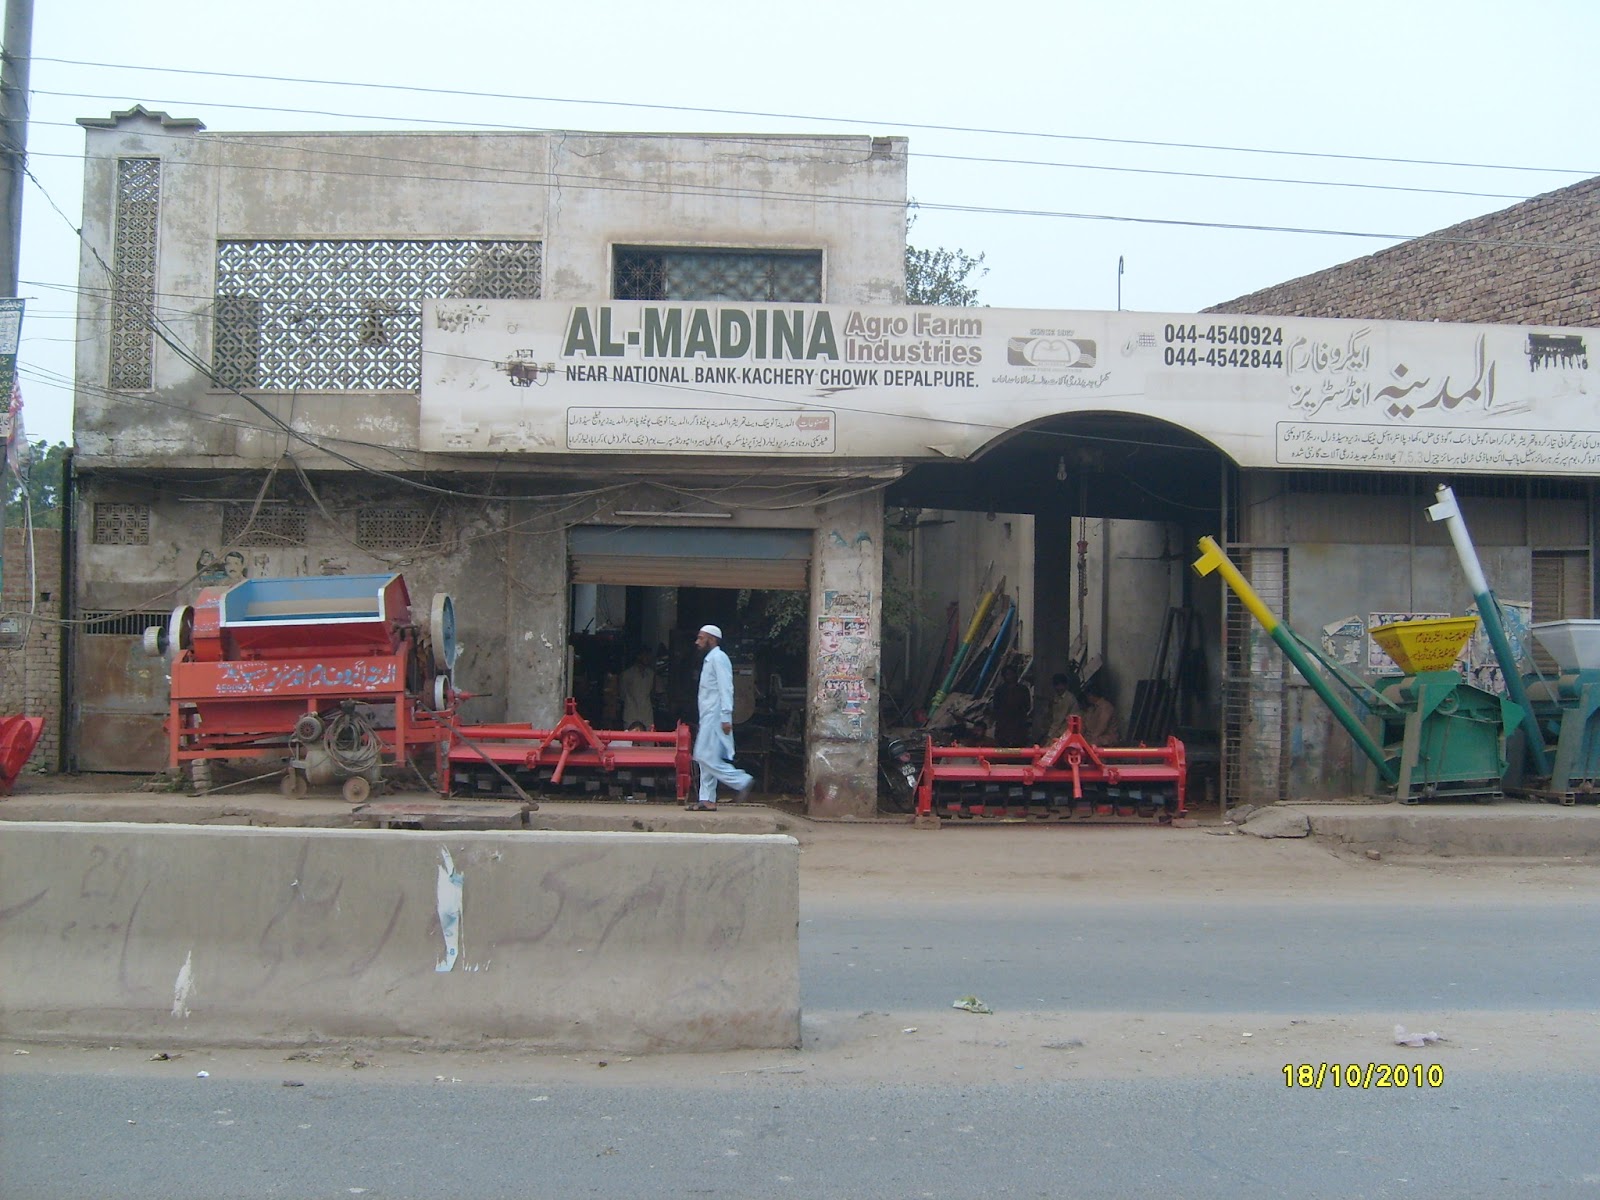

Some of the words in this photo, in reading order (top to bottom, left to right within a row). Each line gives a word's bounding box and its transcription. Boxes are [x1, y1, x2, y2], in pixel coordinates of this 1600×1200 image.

[564, 306, 839, 359] AL-MADINA
[846, 311, 909, 339] Agro
[916, 313, 982, 336] Farm
[1164, 324, 1283, 345] 044-4540924
[847, 339, 982, 363] Industries
[1164, 347, 1283, 368] 044-4542844
[566, 365, 607, 382] NEAR
[613, 366, 689, 384] NATIONAL
[820, 369, 878, 386] CHOWK
[884, 370, 979, 388] DEPALPURE.
